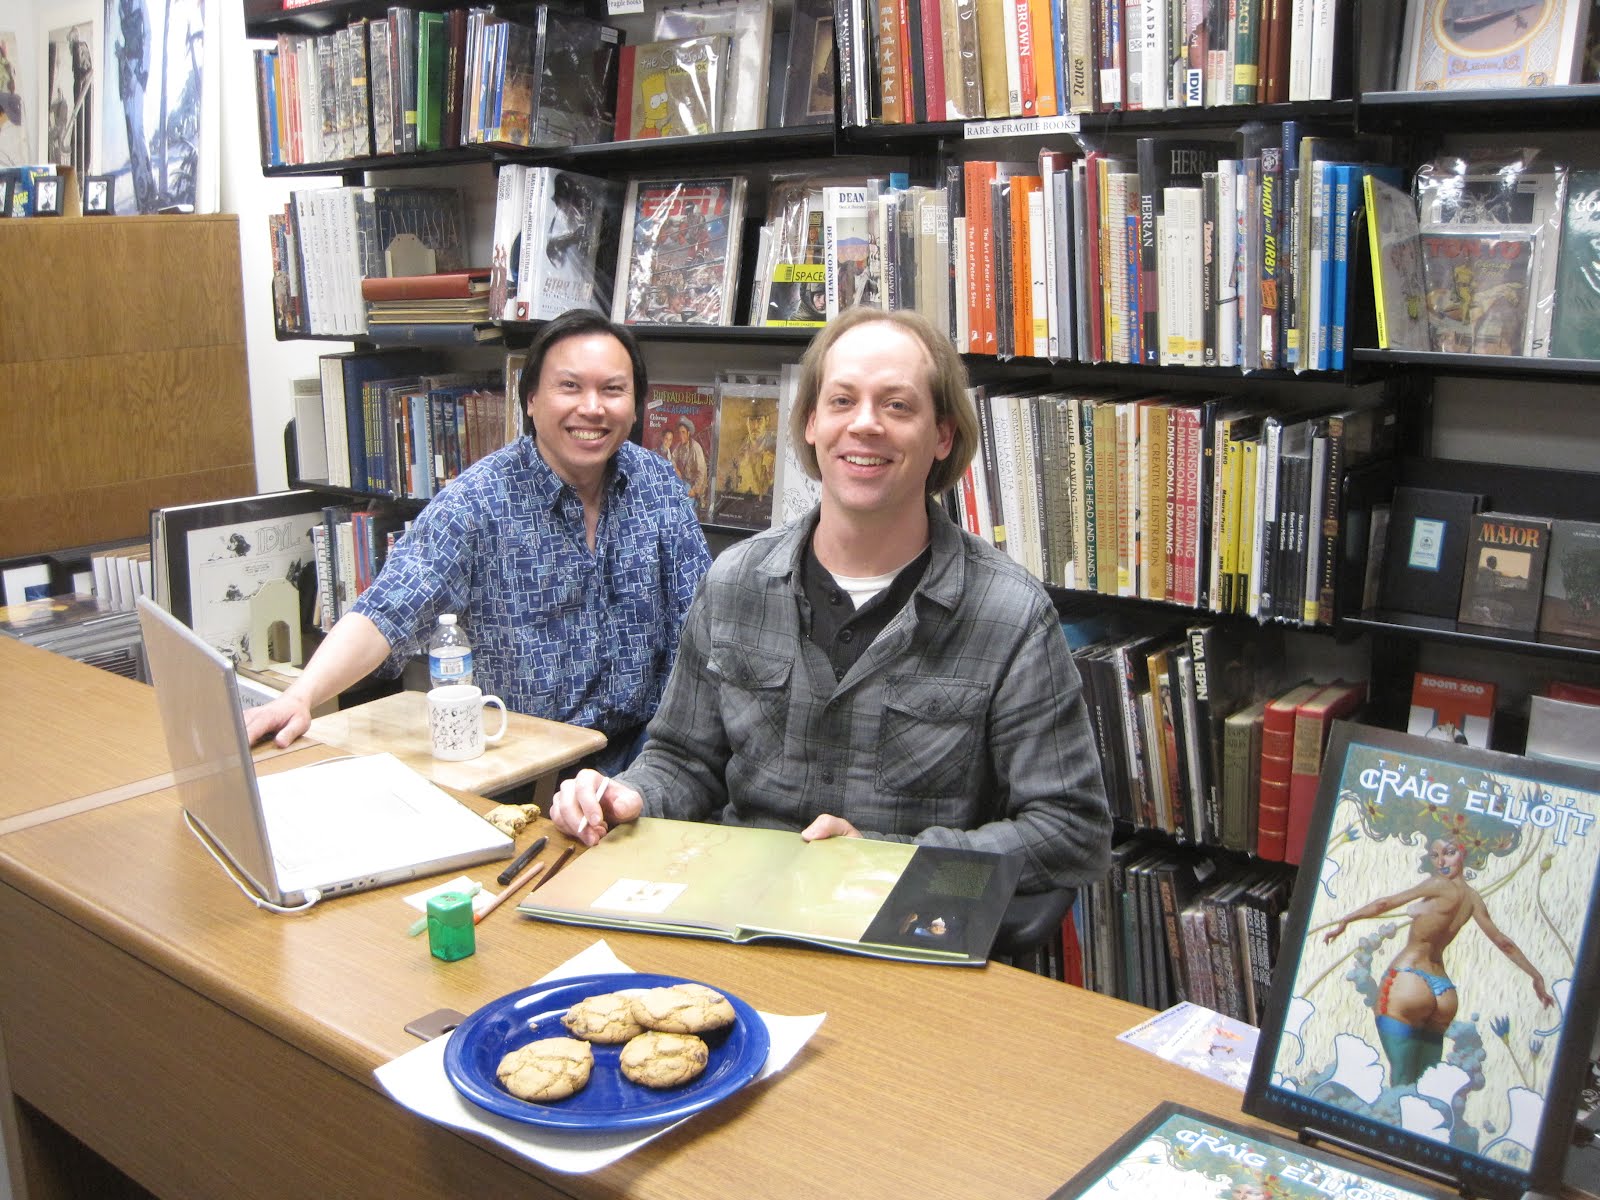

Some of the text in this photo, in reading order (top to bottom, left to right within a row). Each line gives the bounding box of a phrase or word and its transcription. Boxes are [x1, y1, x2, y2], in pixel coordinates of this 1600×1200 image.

[1017, 3, 1030, 56] BROWN
[1189, 72, 1200, 101] IDW
[966, 119, 1076, 136] RARE & FRAGILE BOOKS
[838, 192, 865, 203] DEAN
[1262, 173, 1273, 218] SIMON
[826, 225, 834, 250] DEAN
[982, 227, 990, 241] The
[1141, 194, 1154, 248] HERRAN
[1264, 218, 1272, 233] AND
[523, 242, 532, 282] ILLUSTRATION
[969, 253, 976, 262] of
[1264, 233, 1275, 276] KIRBY
[653, 390, 685, 402] BUFFALO
[979, 398, 987, 428] LIBERATORE
[1000, 417, 1009, 444] JOHN
[1010, 407, 1020, 444] NORMAN
[1022, 408, 1031, 444] NORMAN
[1067, 409, 1075, 448] FIGURE
[1222, 429, 1229, 438] EL
[427, 441, 436, 488] STRANGER
[1013, 445, 1022, 477] LINDSAY
[1025, 445, 1034, 477] LINDSAY
[1166, 414, 1175, 498] 3-DIMENSIONAL
[1176, 415, 1186, 500] 3-DIMENSIONAL
[1186, 417, 1198, 502] 3-DIMENSIONAL
[1068, 451, 1077, 503] DRAWING
[1035, 473, 1046, 531] WATERCOLOURS
[1084, 425, 1096, 578] DRAWING THE HEAD AND HANDS
[1096, 451, 1105, 550] SUCCESSFUL DRAWING
[1107, 451, 1116, 550] SUCCESSFUL DRAWING
[1151, 442, 1161, 567] CREATIVE ILLUSTRATION
[1165, 501, 1174, 555] DRAWING
[1175, 504, 1184, 557] DRAWING
[1185, 505, 1195, 558] DRAWING
[1326, 536, 1334, 556] dave
[1478, 522, 1540, 549] MAJOR
[316, 535, 330, 618] HUMBUG
[1191, 635, 1208, 700] ILYA REPIN
[1460, 682, 1484, 695] zoo
[1378, 759, 1575, 807] THE ART OF
[1359, 768, 1595, 846] CRAIG ELLIOTT
[1246, 906, 1254, 926] FUCK
[1248, 927, 1255, 935] IT
[1253, 908, 1261, 928] FUCK
[1255, 929, 1262, 937] IT
[1249, 935, 1257, 965] NUMBER
[1261, 932, 1268, 940] IT
[1262, 940, 1270, 970] NUMBER
[1264, 1091, 1378, 1137] INTRODUCTION
[1175, 1129, 1267, 1167] CRAIG
